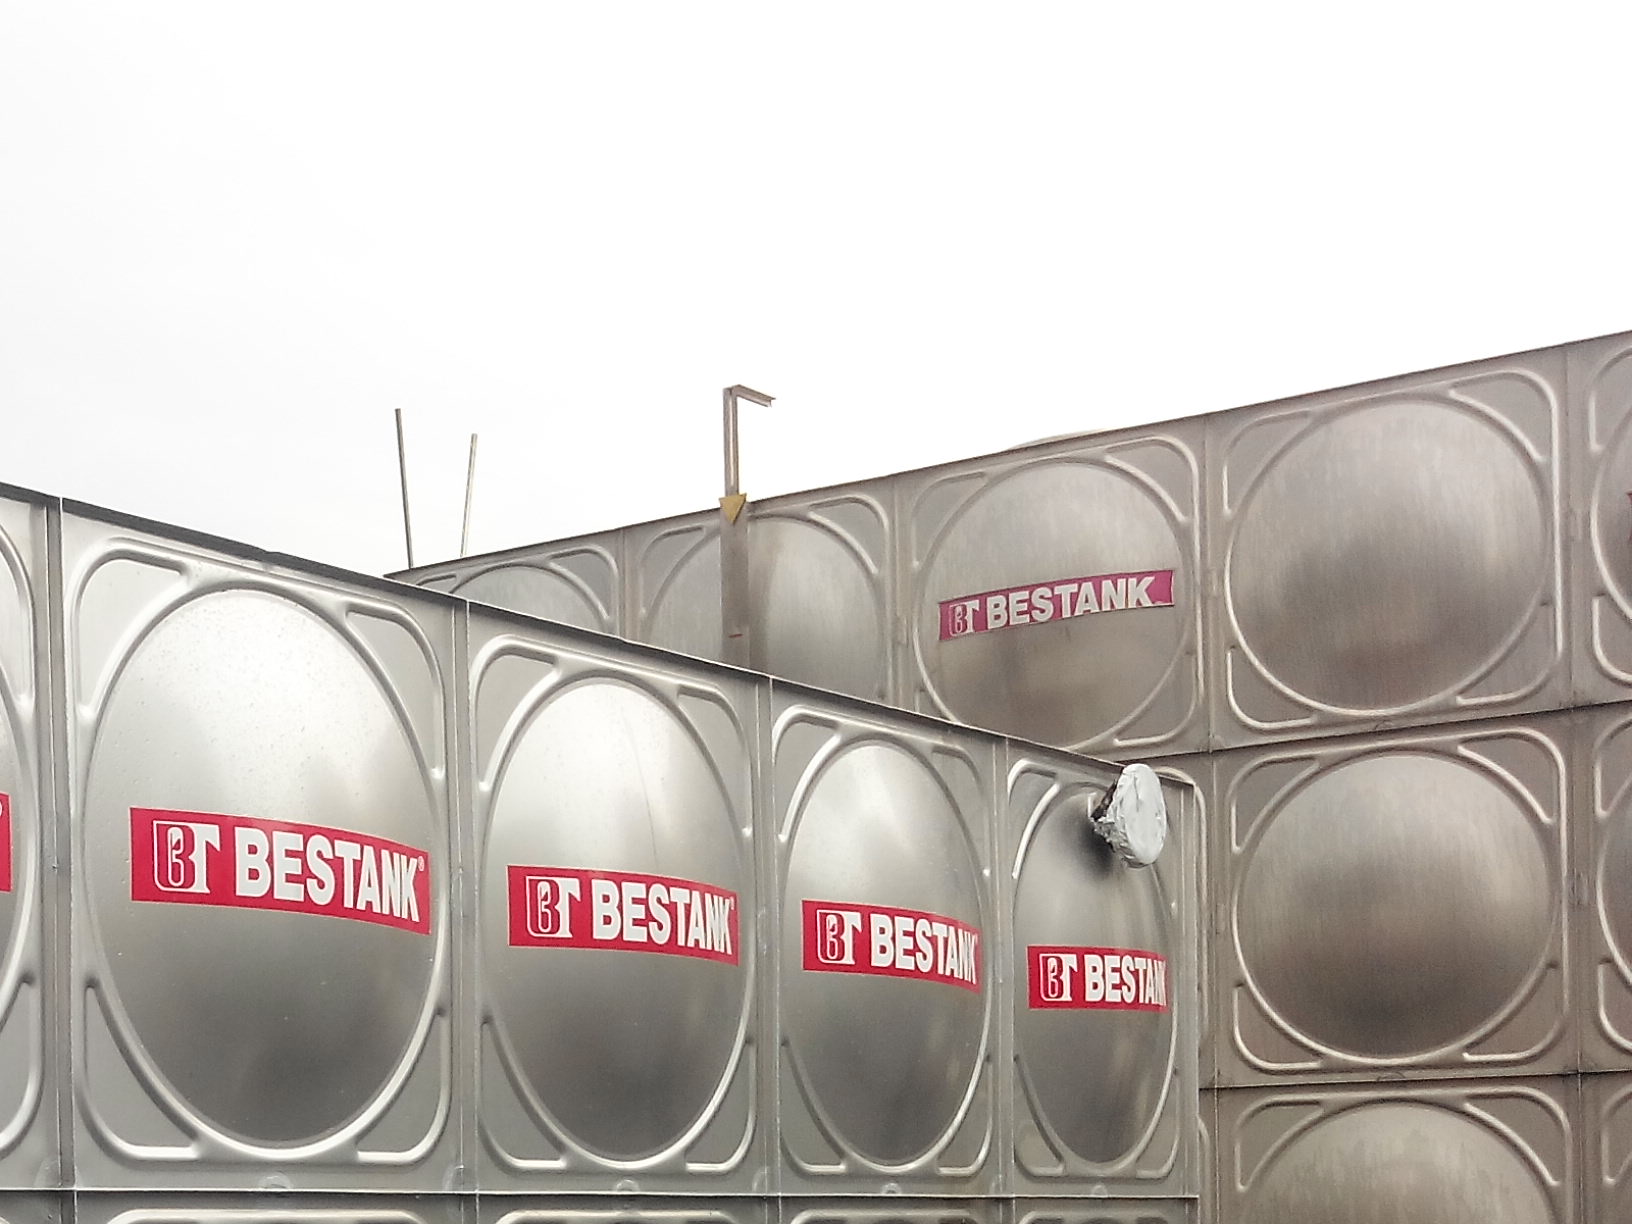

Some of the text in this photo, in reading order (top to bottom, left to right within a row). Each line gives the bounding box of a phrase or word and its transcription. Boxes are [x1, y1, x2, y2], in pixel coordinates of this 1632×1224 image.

[986, 576, 1155, 630] BESTANK
[234, 826, 420, 922] BESTANK
[591, 879, 732, 955] BESTANK
[870, 913, 976, 984] BESTANK
